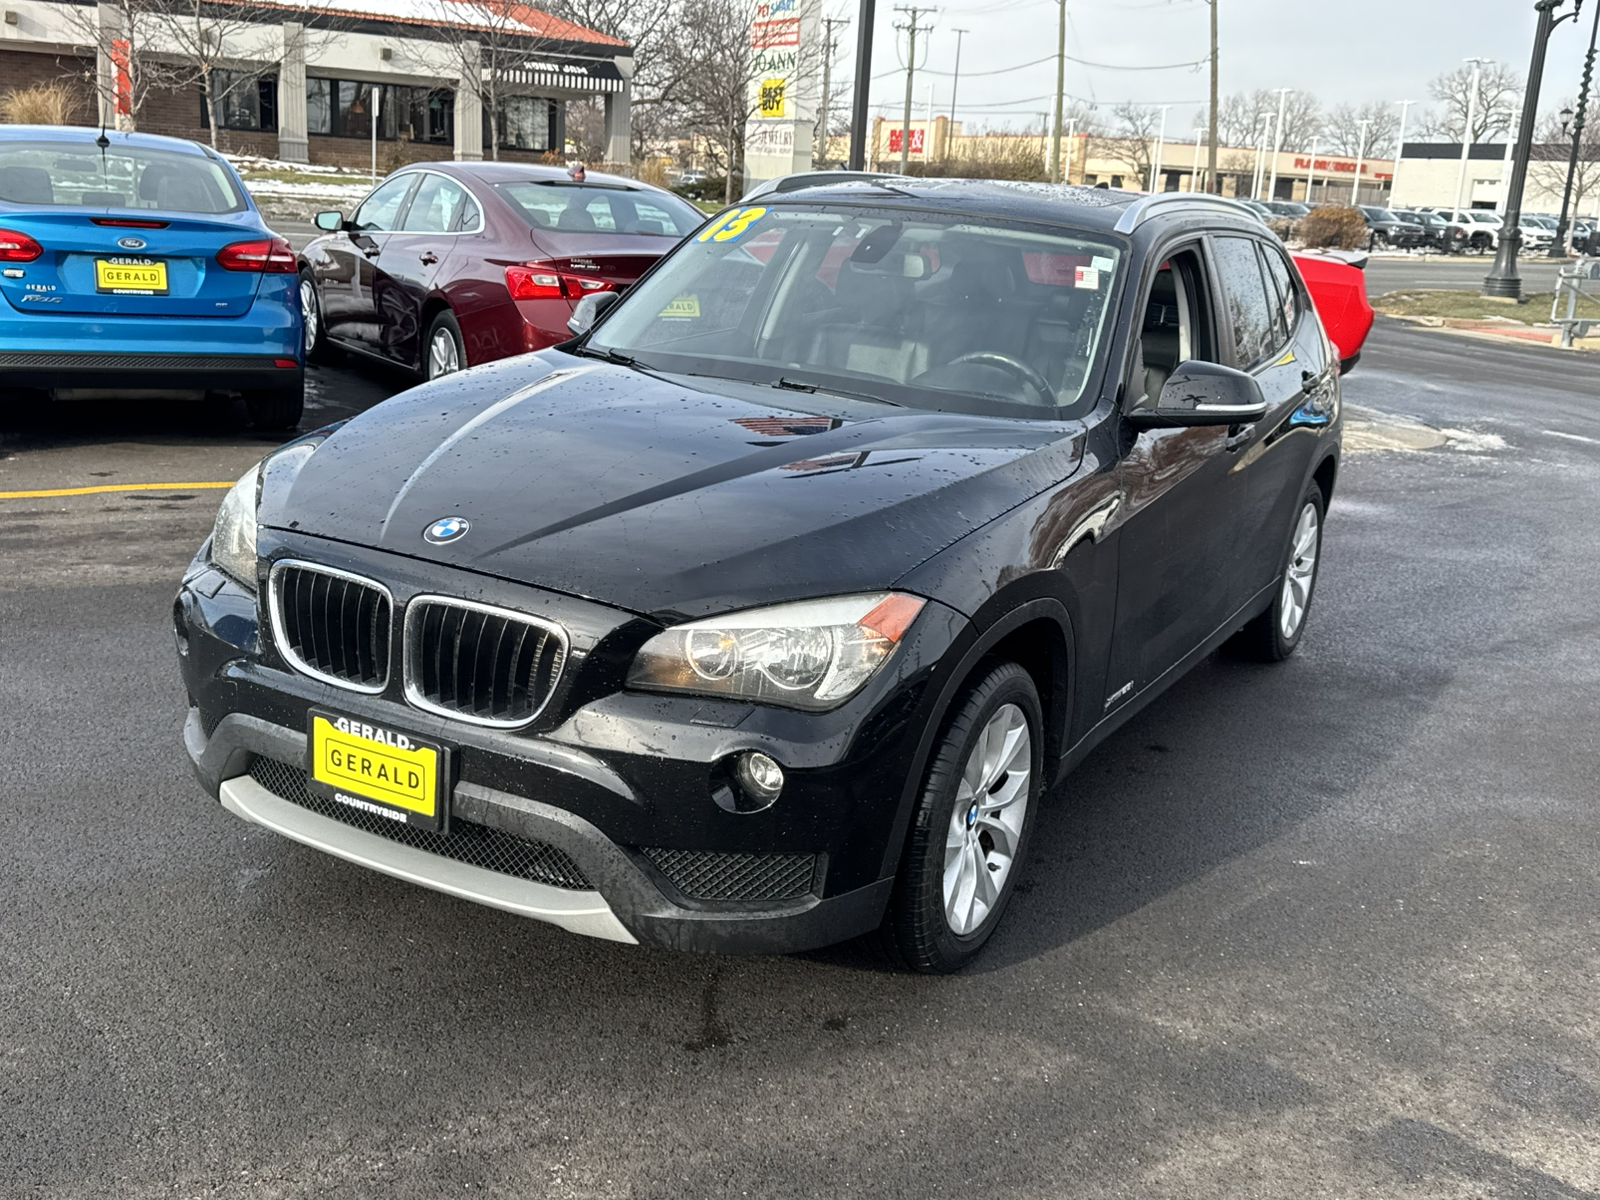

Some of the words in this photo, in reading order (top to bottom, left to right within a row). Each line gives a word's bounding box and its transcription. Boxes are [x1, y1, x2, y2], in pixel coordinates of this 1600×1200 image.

[762, 86, 785, 98] BEST
[762, 99, 781, 110] BUY
[697, 207, 767, 242] 13
[111, 257, 151, 265] GERALD
[106, 271, 157, 282] GERALD
[336, 717, 410, 750] GERALD
[330, 749, 420, 789] GERALD
[334, 793, 407, 823] COUNTRYSIDE
